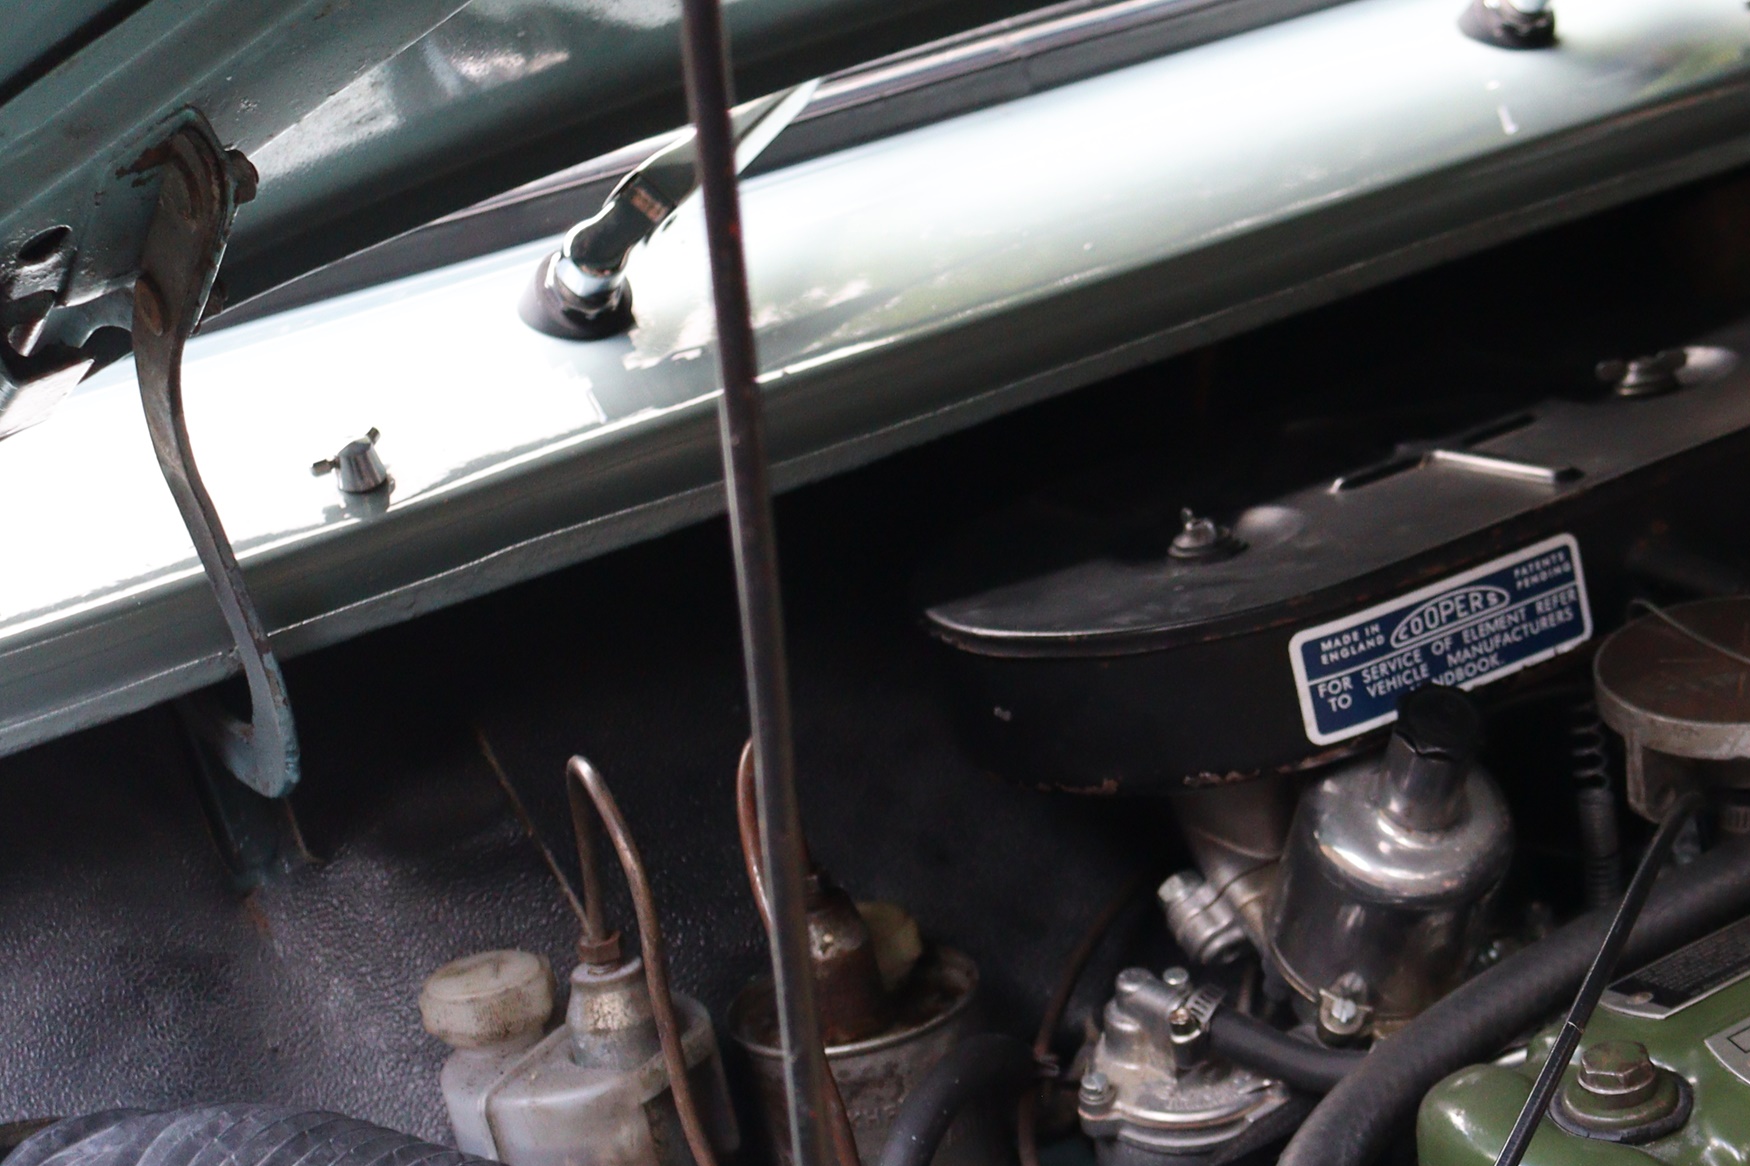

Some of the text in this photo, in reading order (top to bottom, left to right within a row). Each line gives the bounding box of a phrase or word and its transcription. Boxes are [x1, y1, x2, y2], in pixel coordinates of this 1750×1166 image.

[1514, 551, 1565, 578] PATENTS
[1516, 563, 1572, 590] PENDING
[1318, 590, 1577, 699] FOR SERVICE OF ELEMENT REFER
[1320, 623, 1381, 651] MADE IN
[1321, 634, 1385, 665] ENGLAND
[1327, 607, 1574, 711] TO VEHICLE MANUFACTURERS
